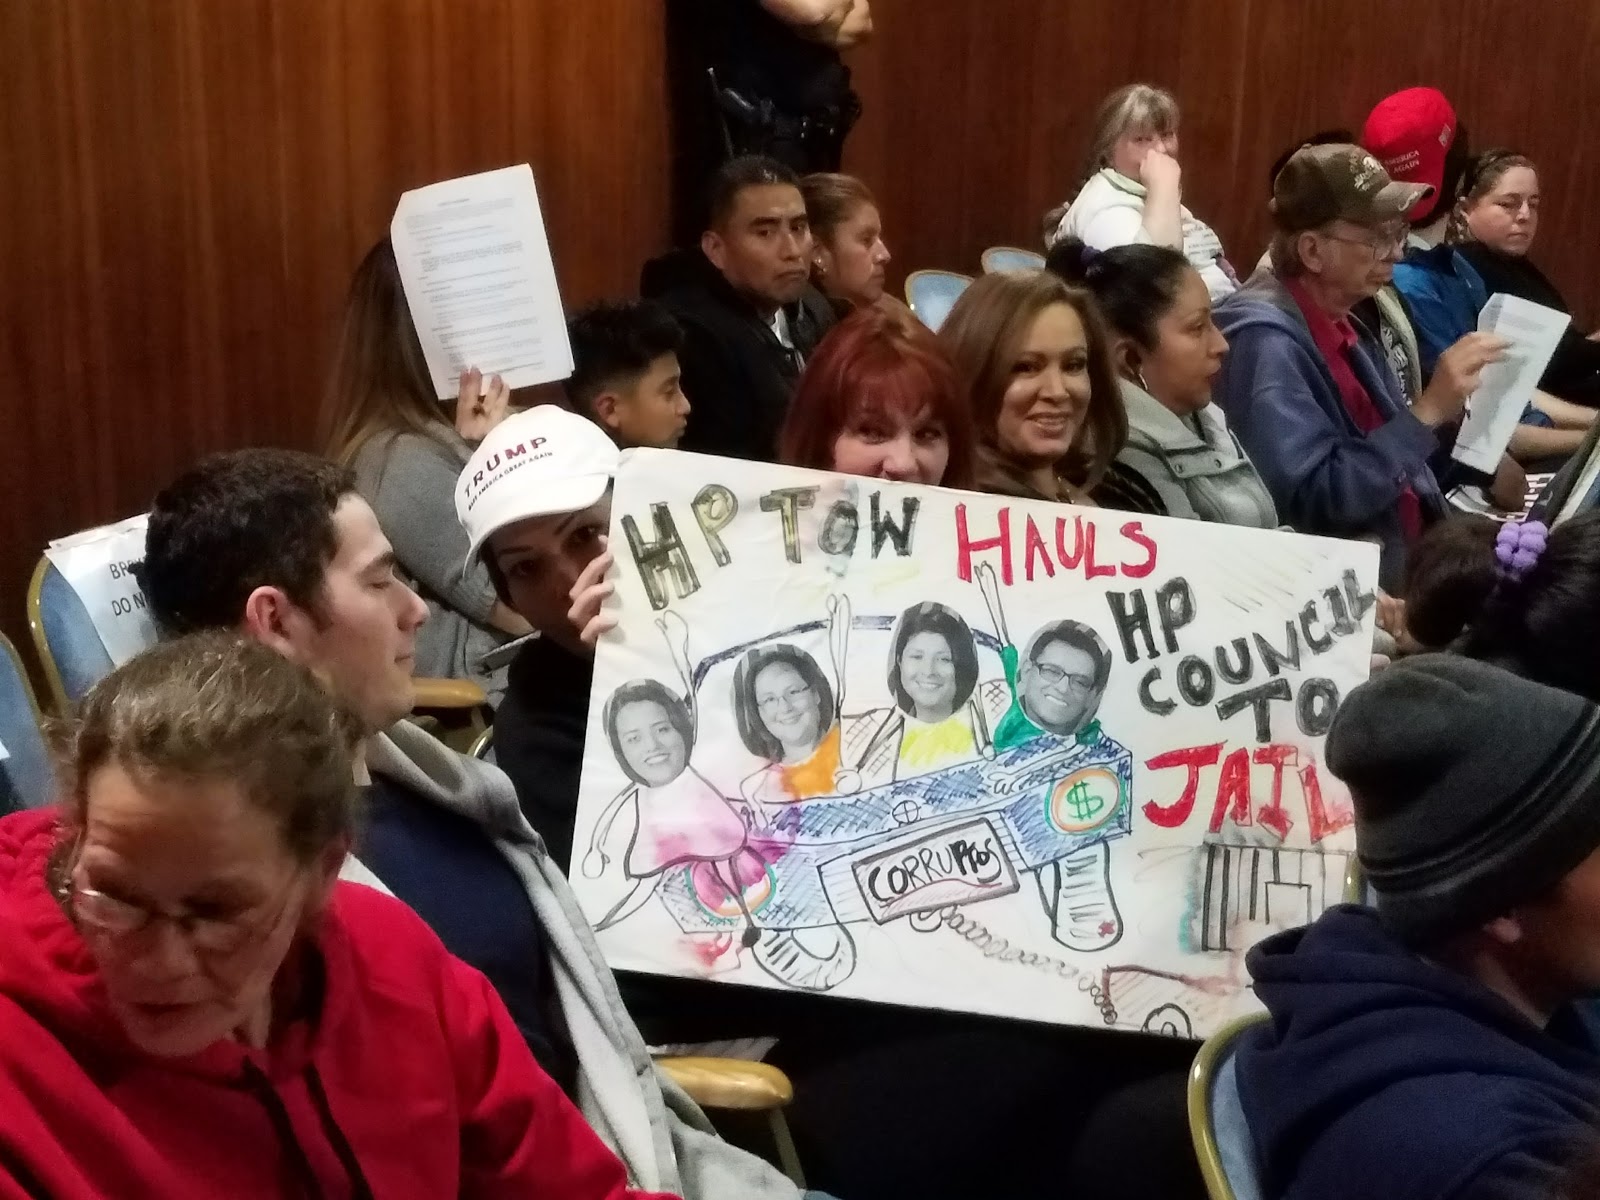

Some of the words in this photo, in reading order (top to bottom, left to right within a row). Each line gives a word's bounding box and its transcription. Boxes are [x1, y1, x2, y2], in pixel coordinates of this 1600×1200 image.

[464, 436, 547, 498] TRUMP
[478, 473, 504, 496] AMERICA
[528, 452, 553, 463] AGAIN
[620, 483, 739, 611] HP
[760, 484, 921, 565] TOW
[954, 502, 1158, 586] HAULS
[111, 597, 131, 616] DO
[1106, 576, 1197, 664] HP
[1137, 568, 1377, 717] COUNCIL
[1215, 677, 1339, 743] TO
[1141, 740, 1355, 844] JAIL
